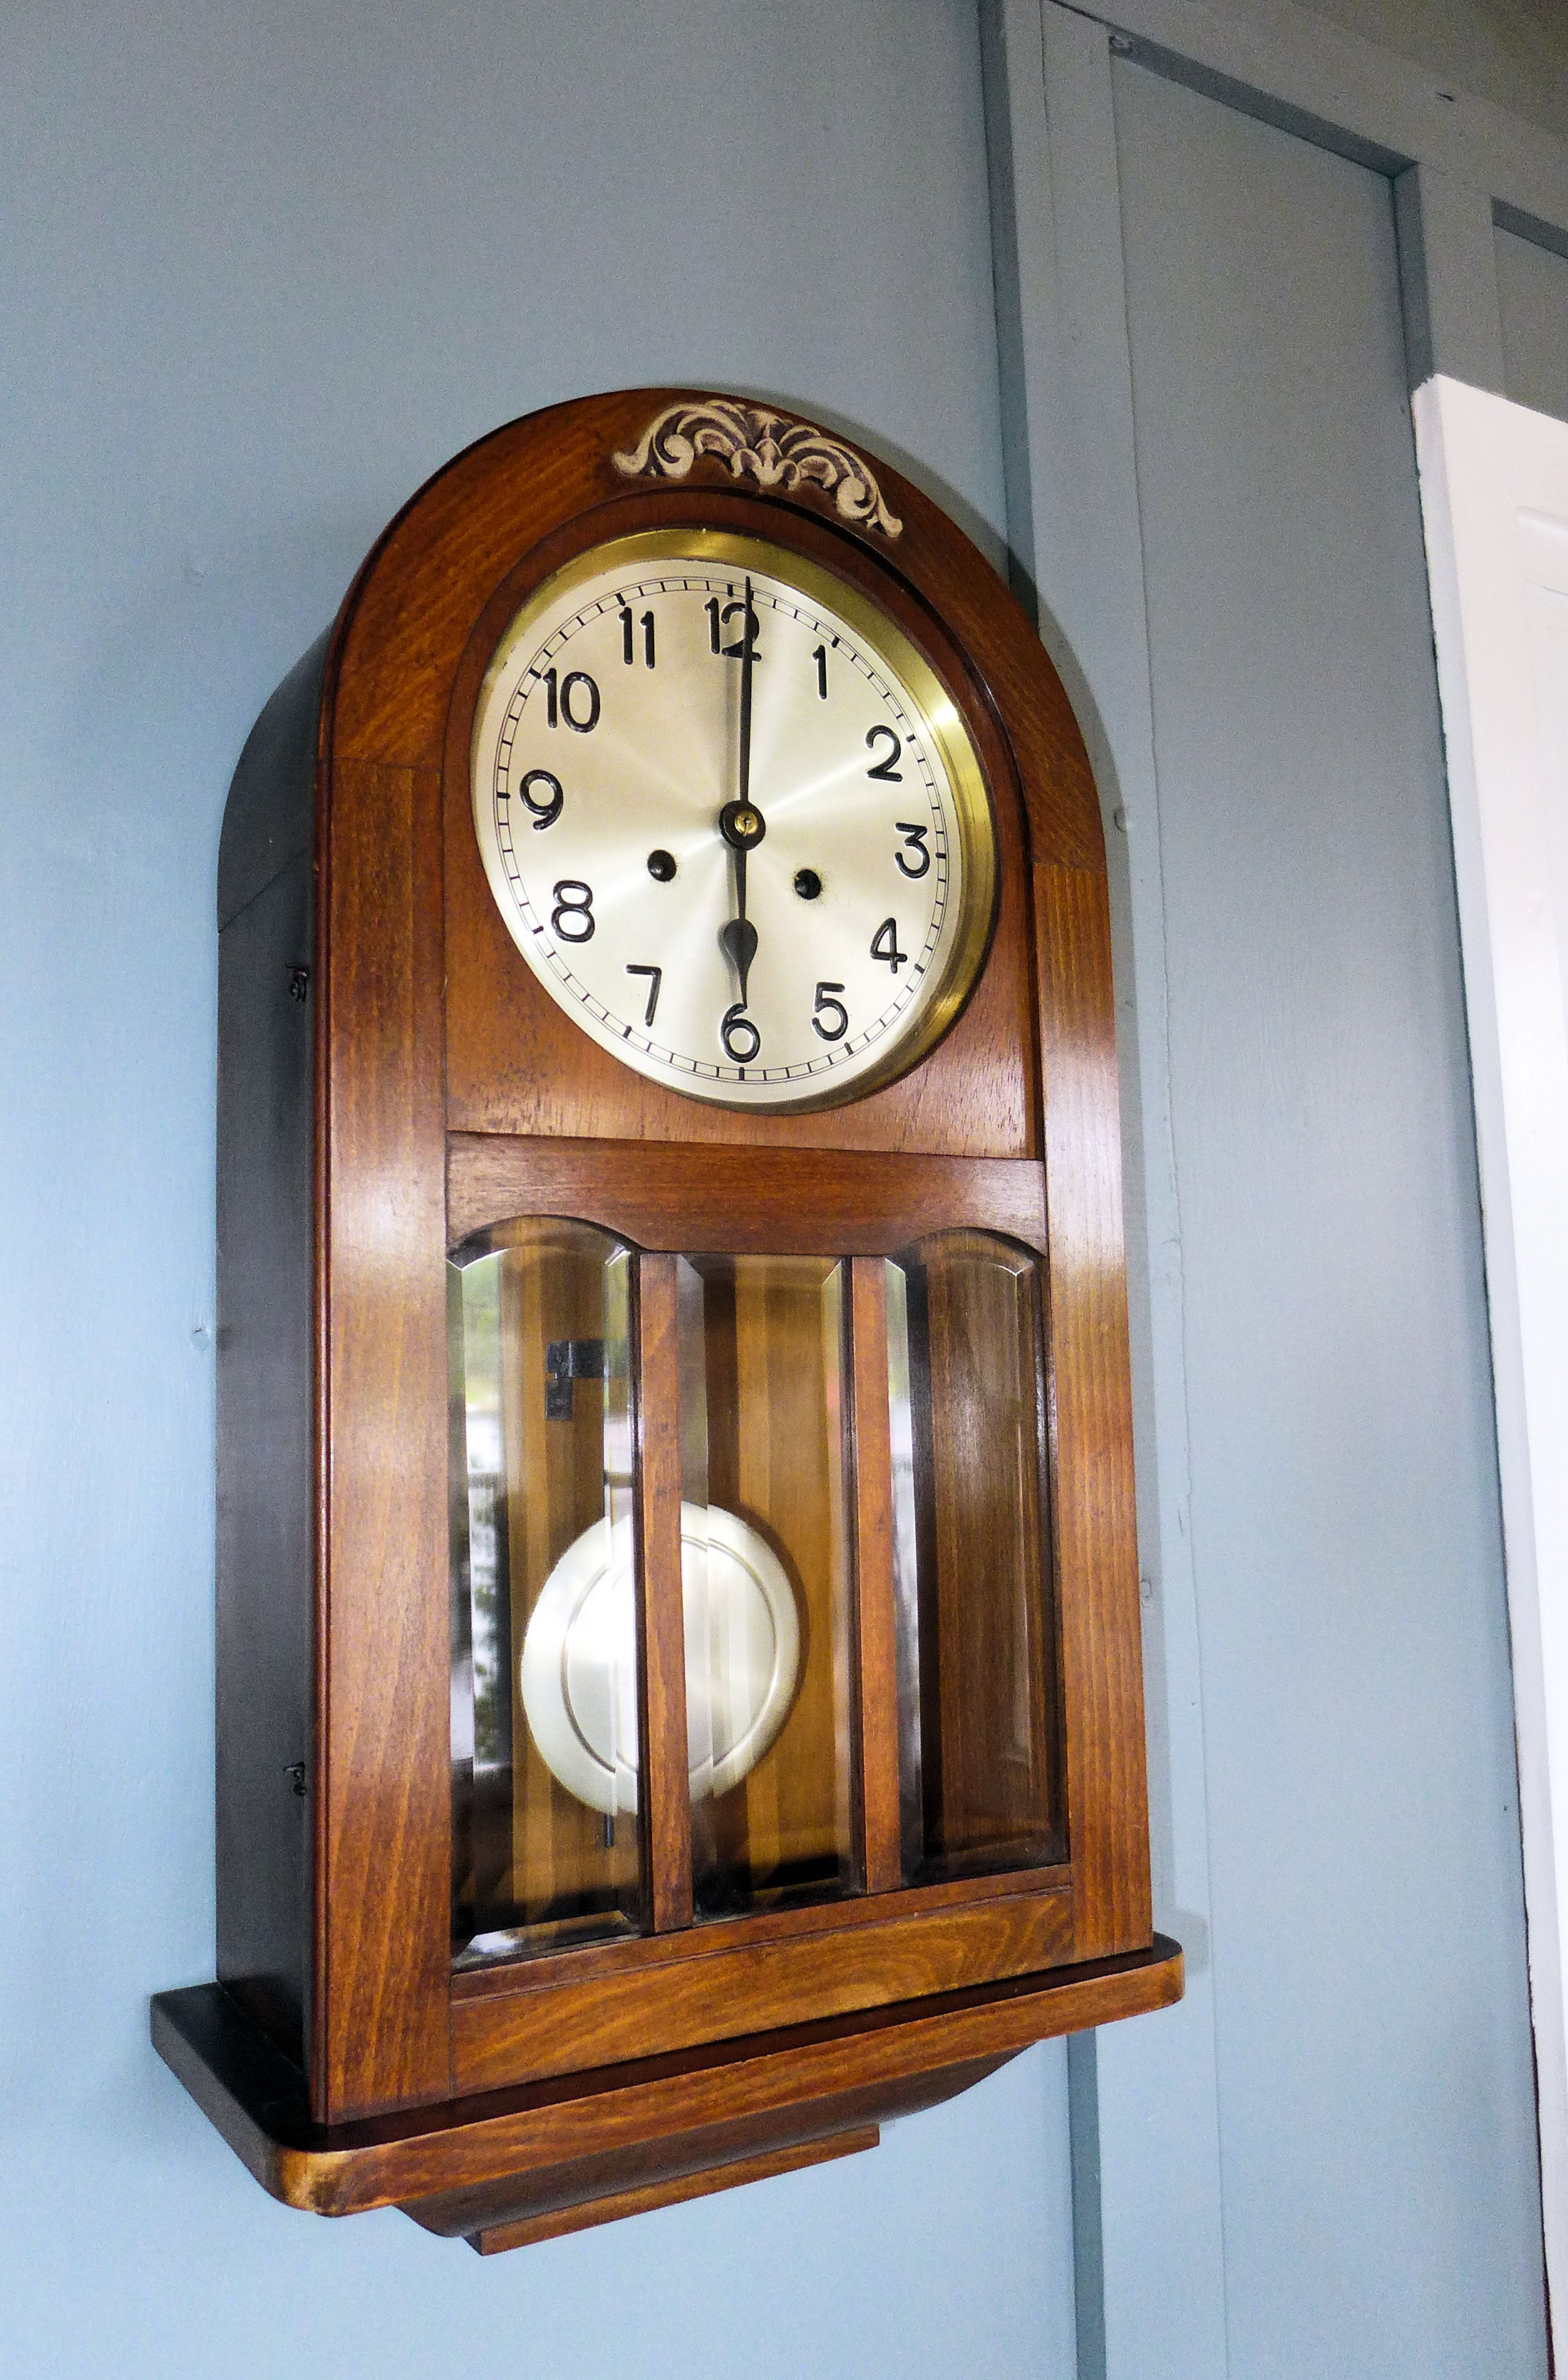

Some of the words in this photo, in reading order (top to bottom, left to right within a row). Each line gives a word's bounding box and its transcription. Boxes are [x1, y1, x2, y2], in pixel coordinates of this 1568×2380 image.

[619, 606, 656, 669] 11
[704, 597, 761, 662] 12
[542, 668, 601, 733] 10
[812, 644, 827, 699] 1
[865, 725, 903, 782] 2
[519, 769, 564, 830] 9
[894, 823, 930, 879] 3
[550, 880, 595, 942] 8
[870, 917, 907, 974] 4
[626, 964, 662, 1026] 7
[812, 982, 849, 1041] 5
[721, 1004, 760, 1063] 6
